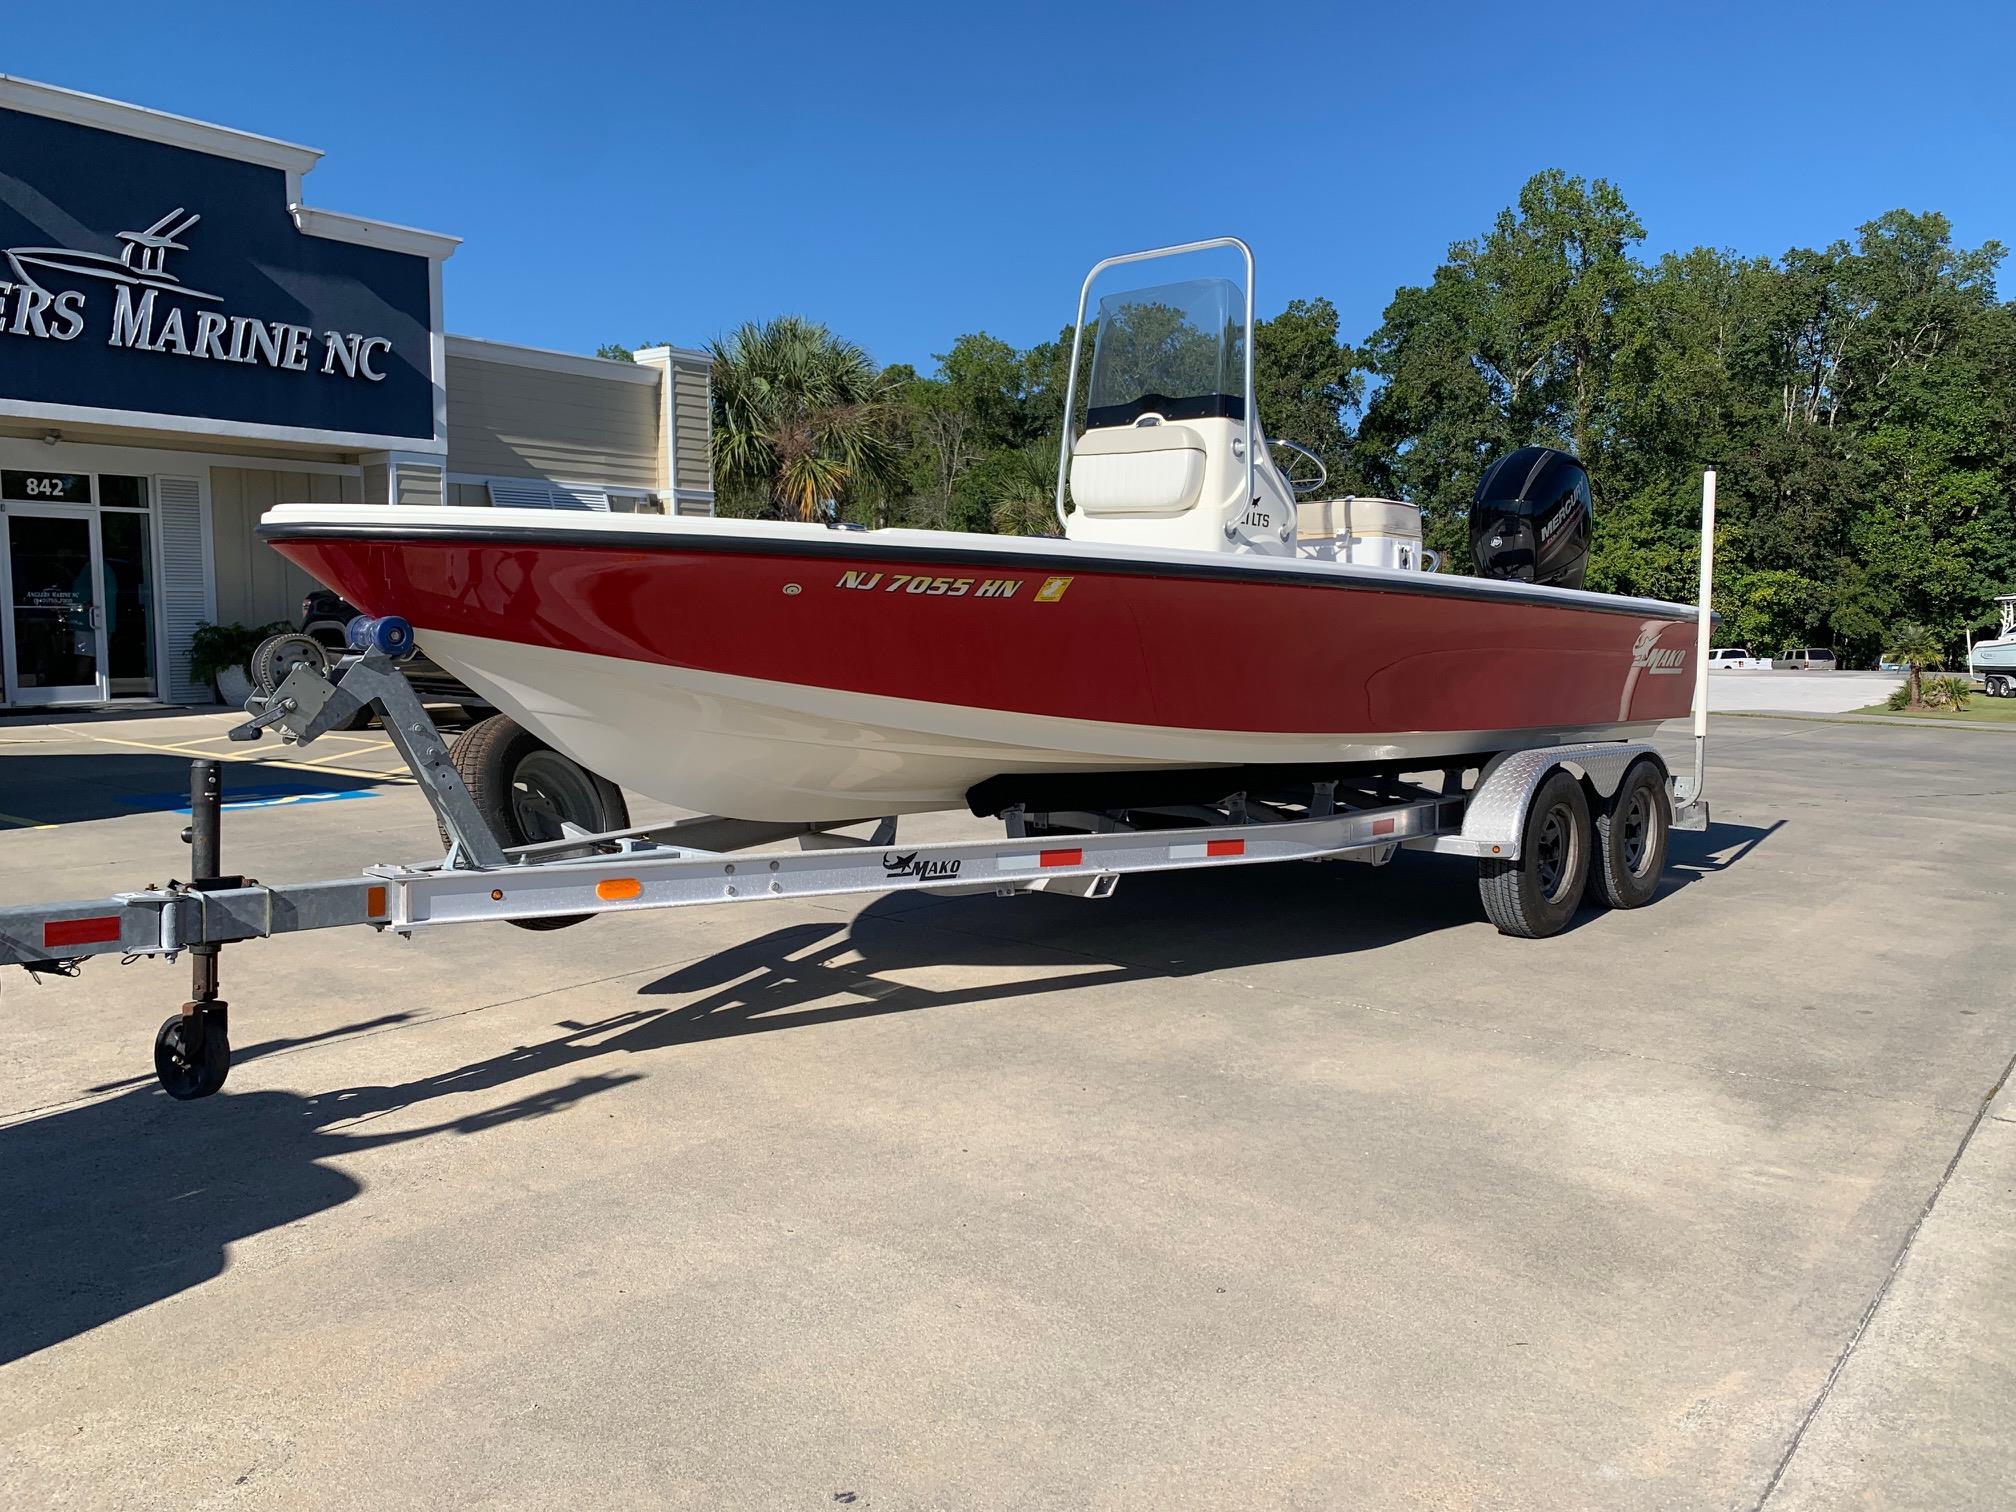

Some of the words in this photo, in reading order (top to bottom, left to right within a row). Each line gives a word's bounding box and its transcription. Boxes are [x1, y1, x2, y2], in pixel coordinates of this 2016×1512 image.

[108, 284, 312, 372] MARINE
[320, 330, 392, 382] NC
[25, 478, 64, 497] 842
[1251, 512, 1270, 528] LTS
[1541, 475, 1584, 542] MERCURY
[836, 570, 885, 591] NJ
[885, 574, 975, 597] 7055
[974, 579, 1024, 599] HN
[1645, 648, 1687, 675] MAKO
[911, 860, 961, 882] MAKO
